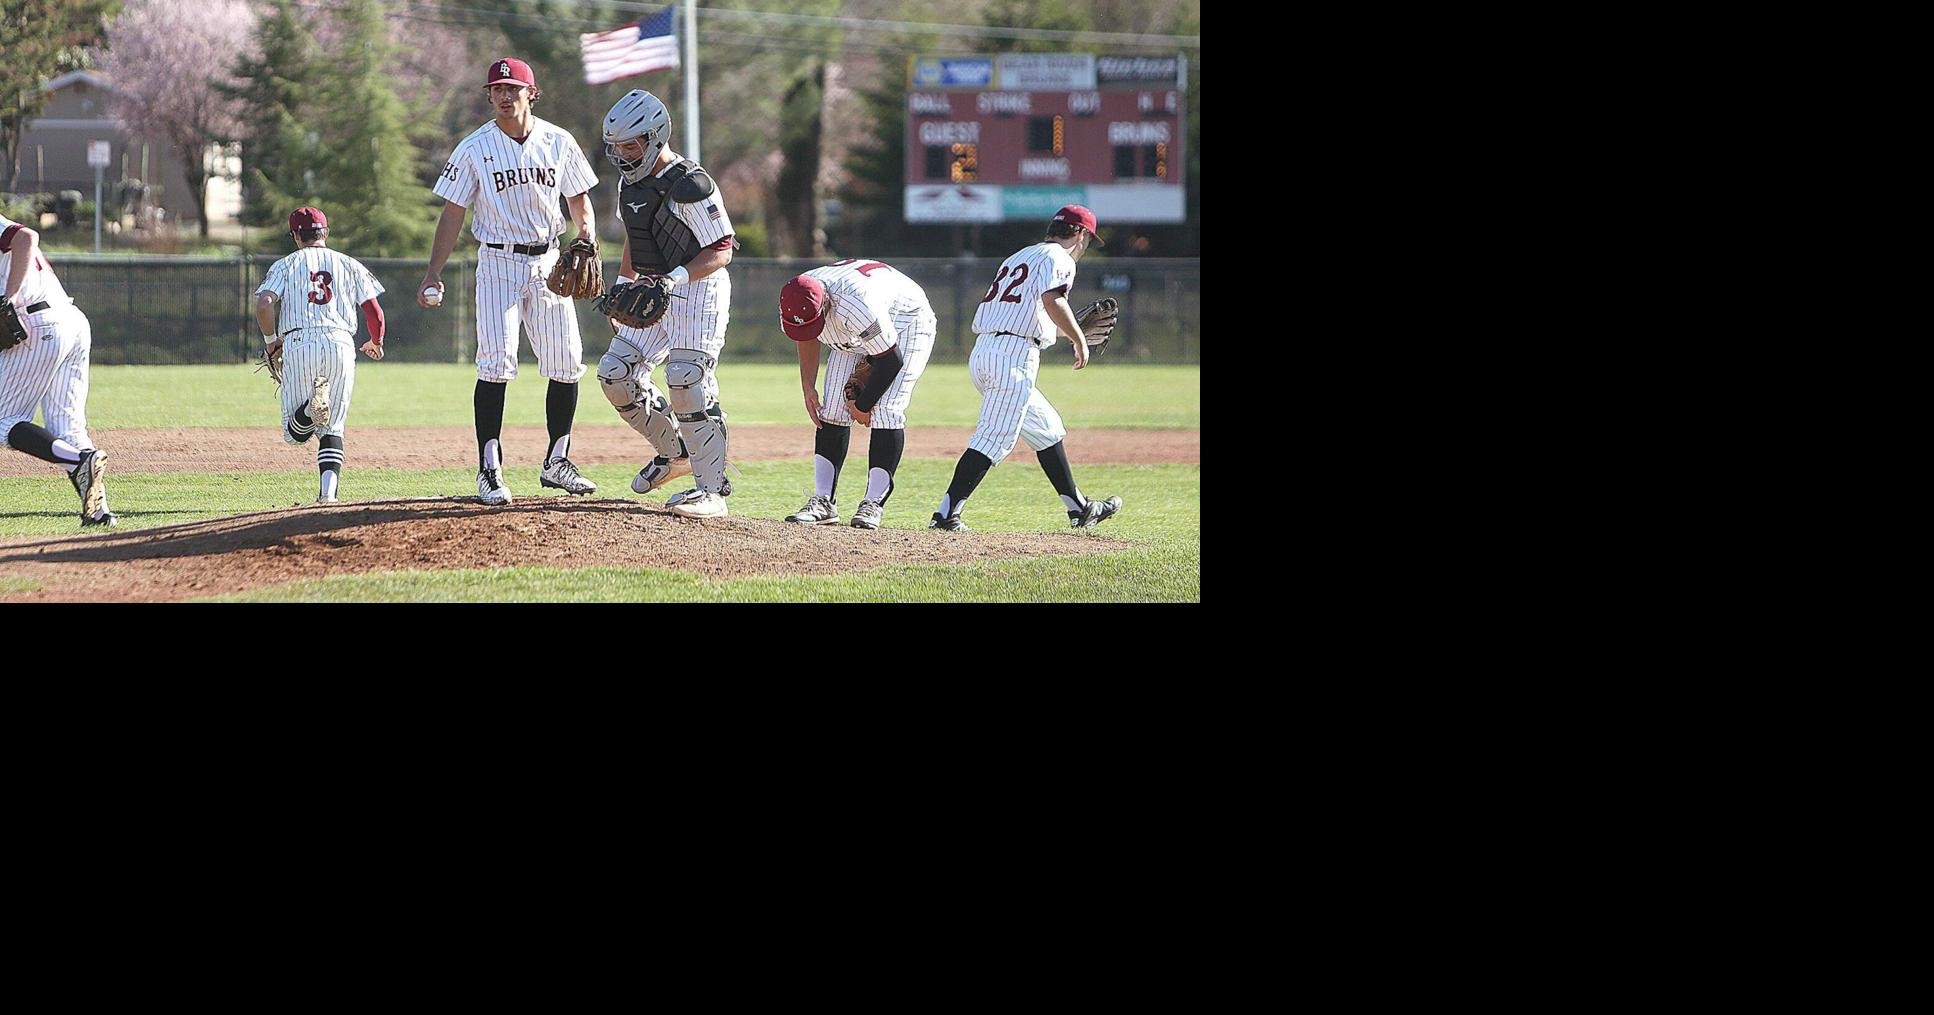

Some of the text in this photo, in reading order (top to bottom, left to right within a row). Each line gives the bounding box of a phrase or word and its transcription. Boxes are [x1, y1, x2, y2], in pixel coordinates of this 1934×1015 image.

[909, 92, 950, 113] BALL
[976, 91, 1031, 114] STRIKE
[1067, 91, 1101, 114] OUT
[919, 121, 980, 144] GUEST
[1053, 116, 1064, 156] 1
[1108, 121, 1170, 144] BRUINS
[951, 143, 976, 182] 2
[1018, 158, 1070, 178] INNING
[493, 167, 556, 193] BRUINS
[308, 270, 333, 305] 3
[981, 263, 1028, 304] 32
